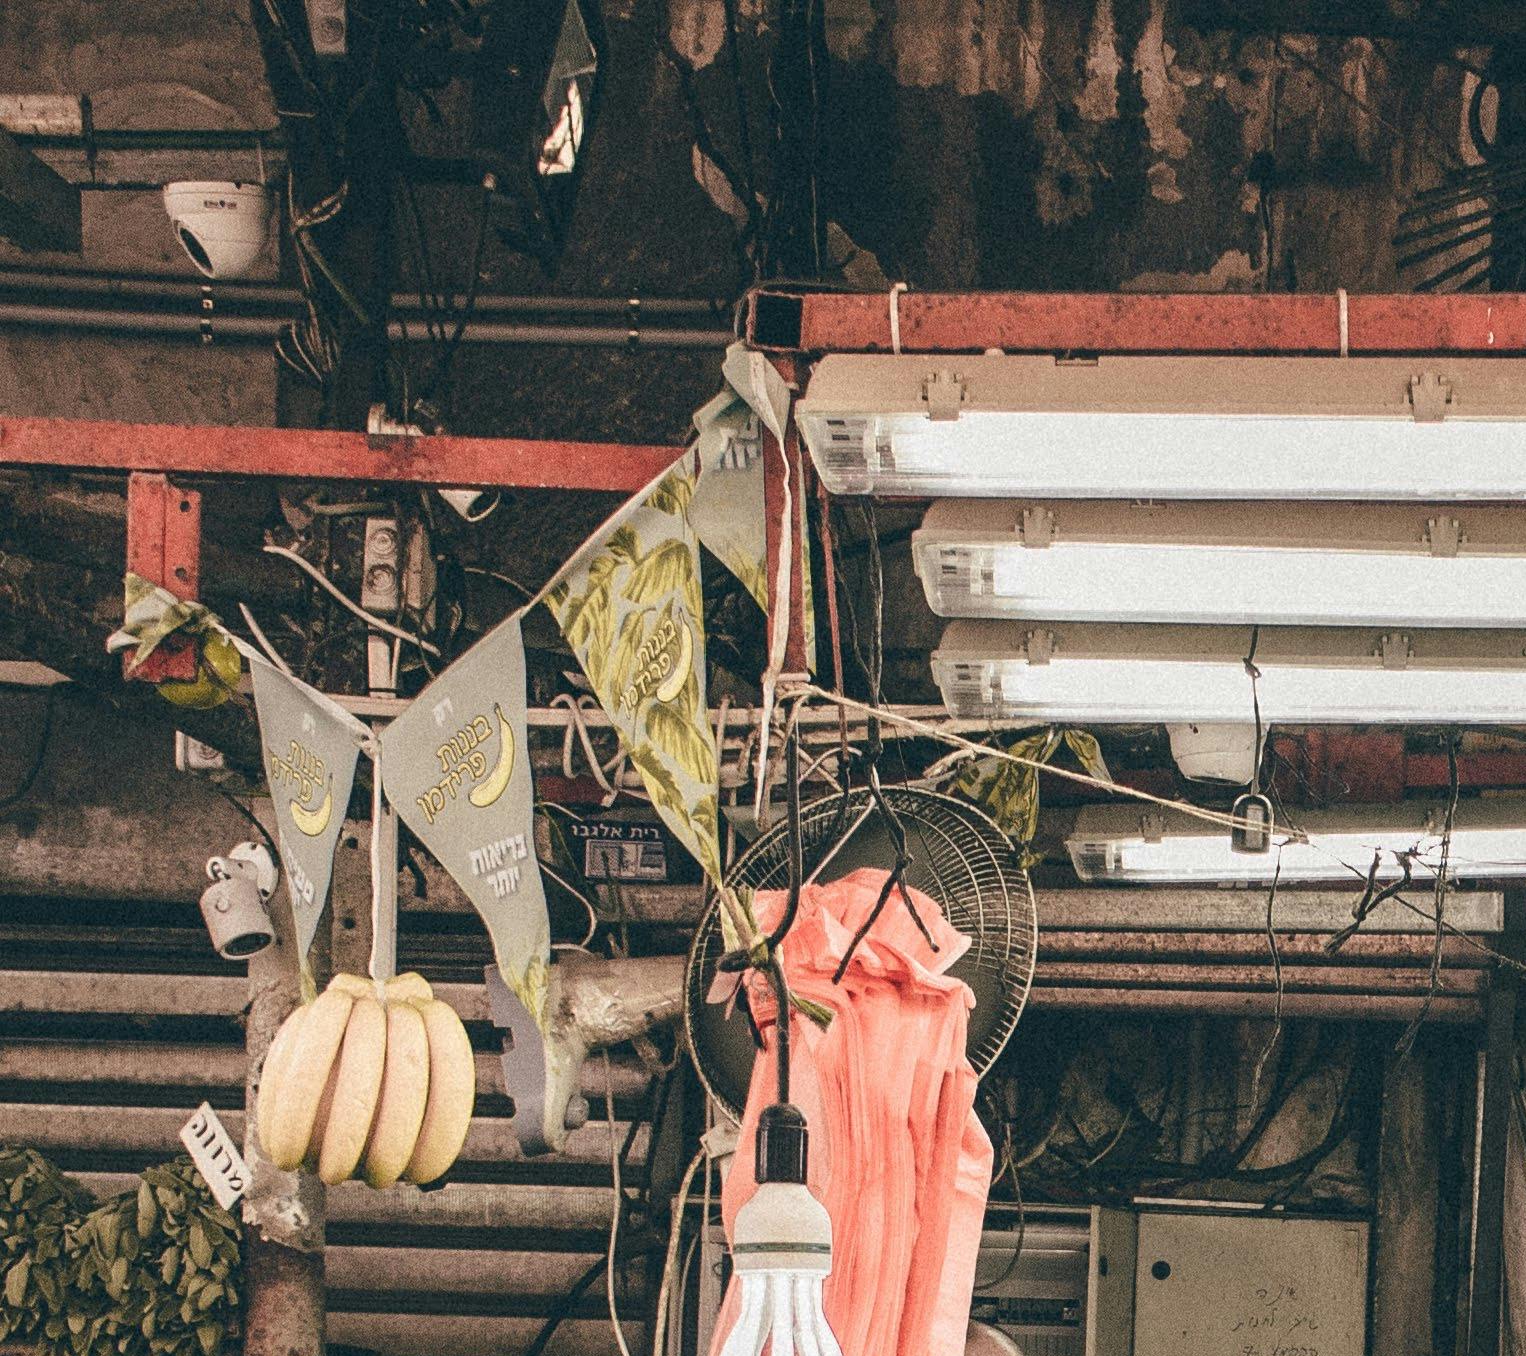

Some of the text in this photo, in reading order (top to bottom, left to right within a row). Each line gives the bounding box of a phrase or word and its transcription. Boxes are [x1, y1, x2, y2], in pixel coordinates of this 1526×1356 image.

[436, 714, 493, 773] בננות
[417, 751, 487, 824] פרידמן
[468, 833, 528, 876] בריאות
